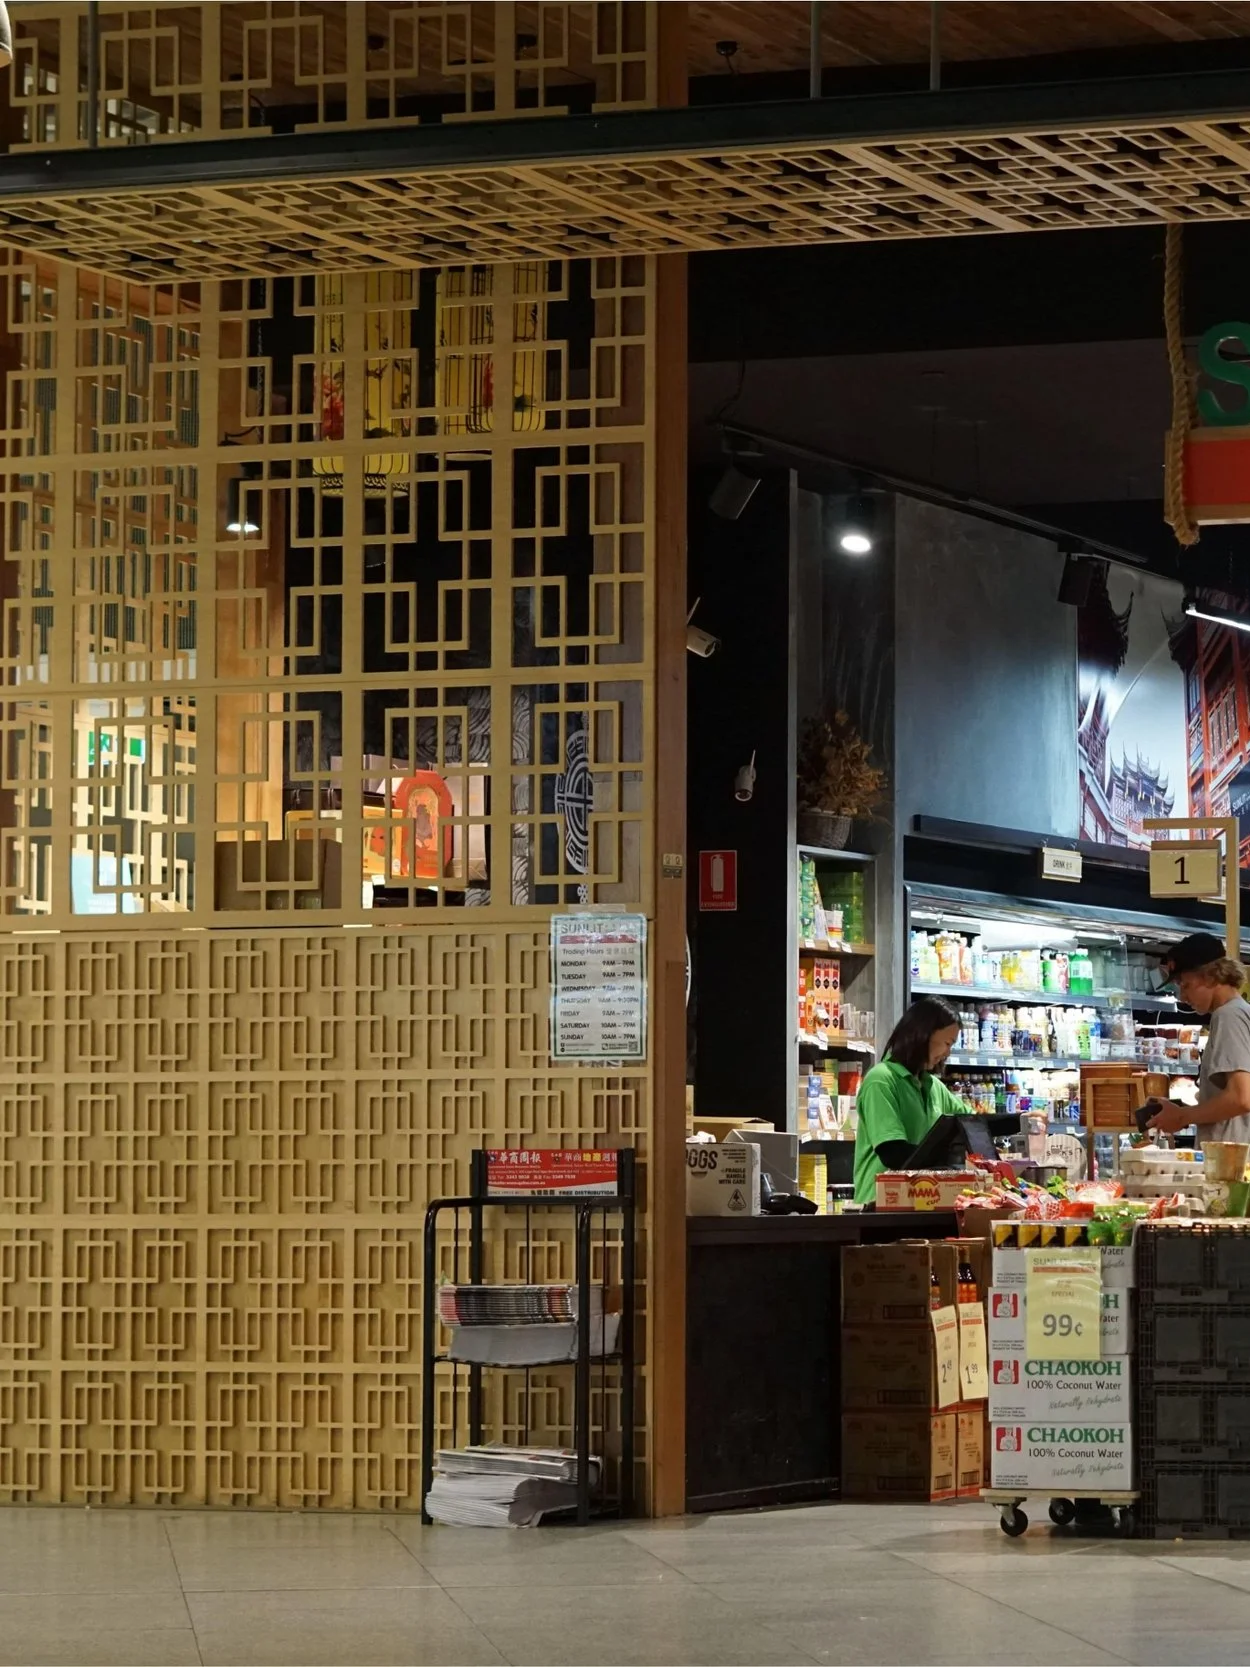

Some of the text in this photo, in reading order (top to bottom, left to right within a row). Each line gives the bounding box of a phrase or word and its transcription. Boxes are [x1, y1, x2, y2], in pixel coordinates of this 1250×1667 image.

[1174, 856, 1190, 885] 1
[563, 948, 586, 956] Trading
[686, 1149, 718, 1170] GGS
[907, 1187, 940, 1199] MAMA
[1100, 1315, 1119, 1323] ater
[1024, 1360, 1122, 1376] CHAOKOH
[1027, 1380, 1121, 1390] 100% Coconut Water
[1027, 1427, 1125, 1443] CHAOKOH
[1029, 1448, 1123, 1458] 100% Coconut Water
